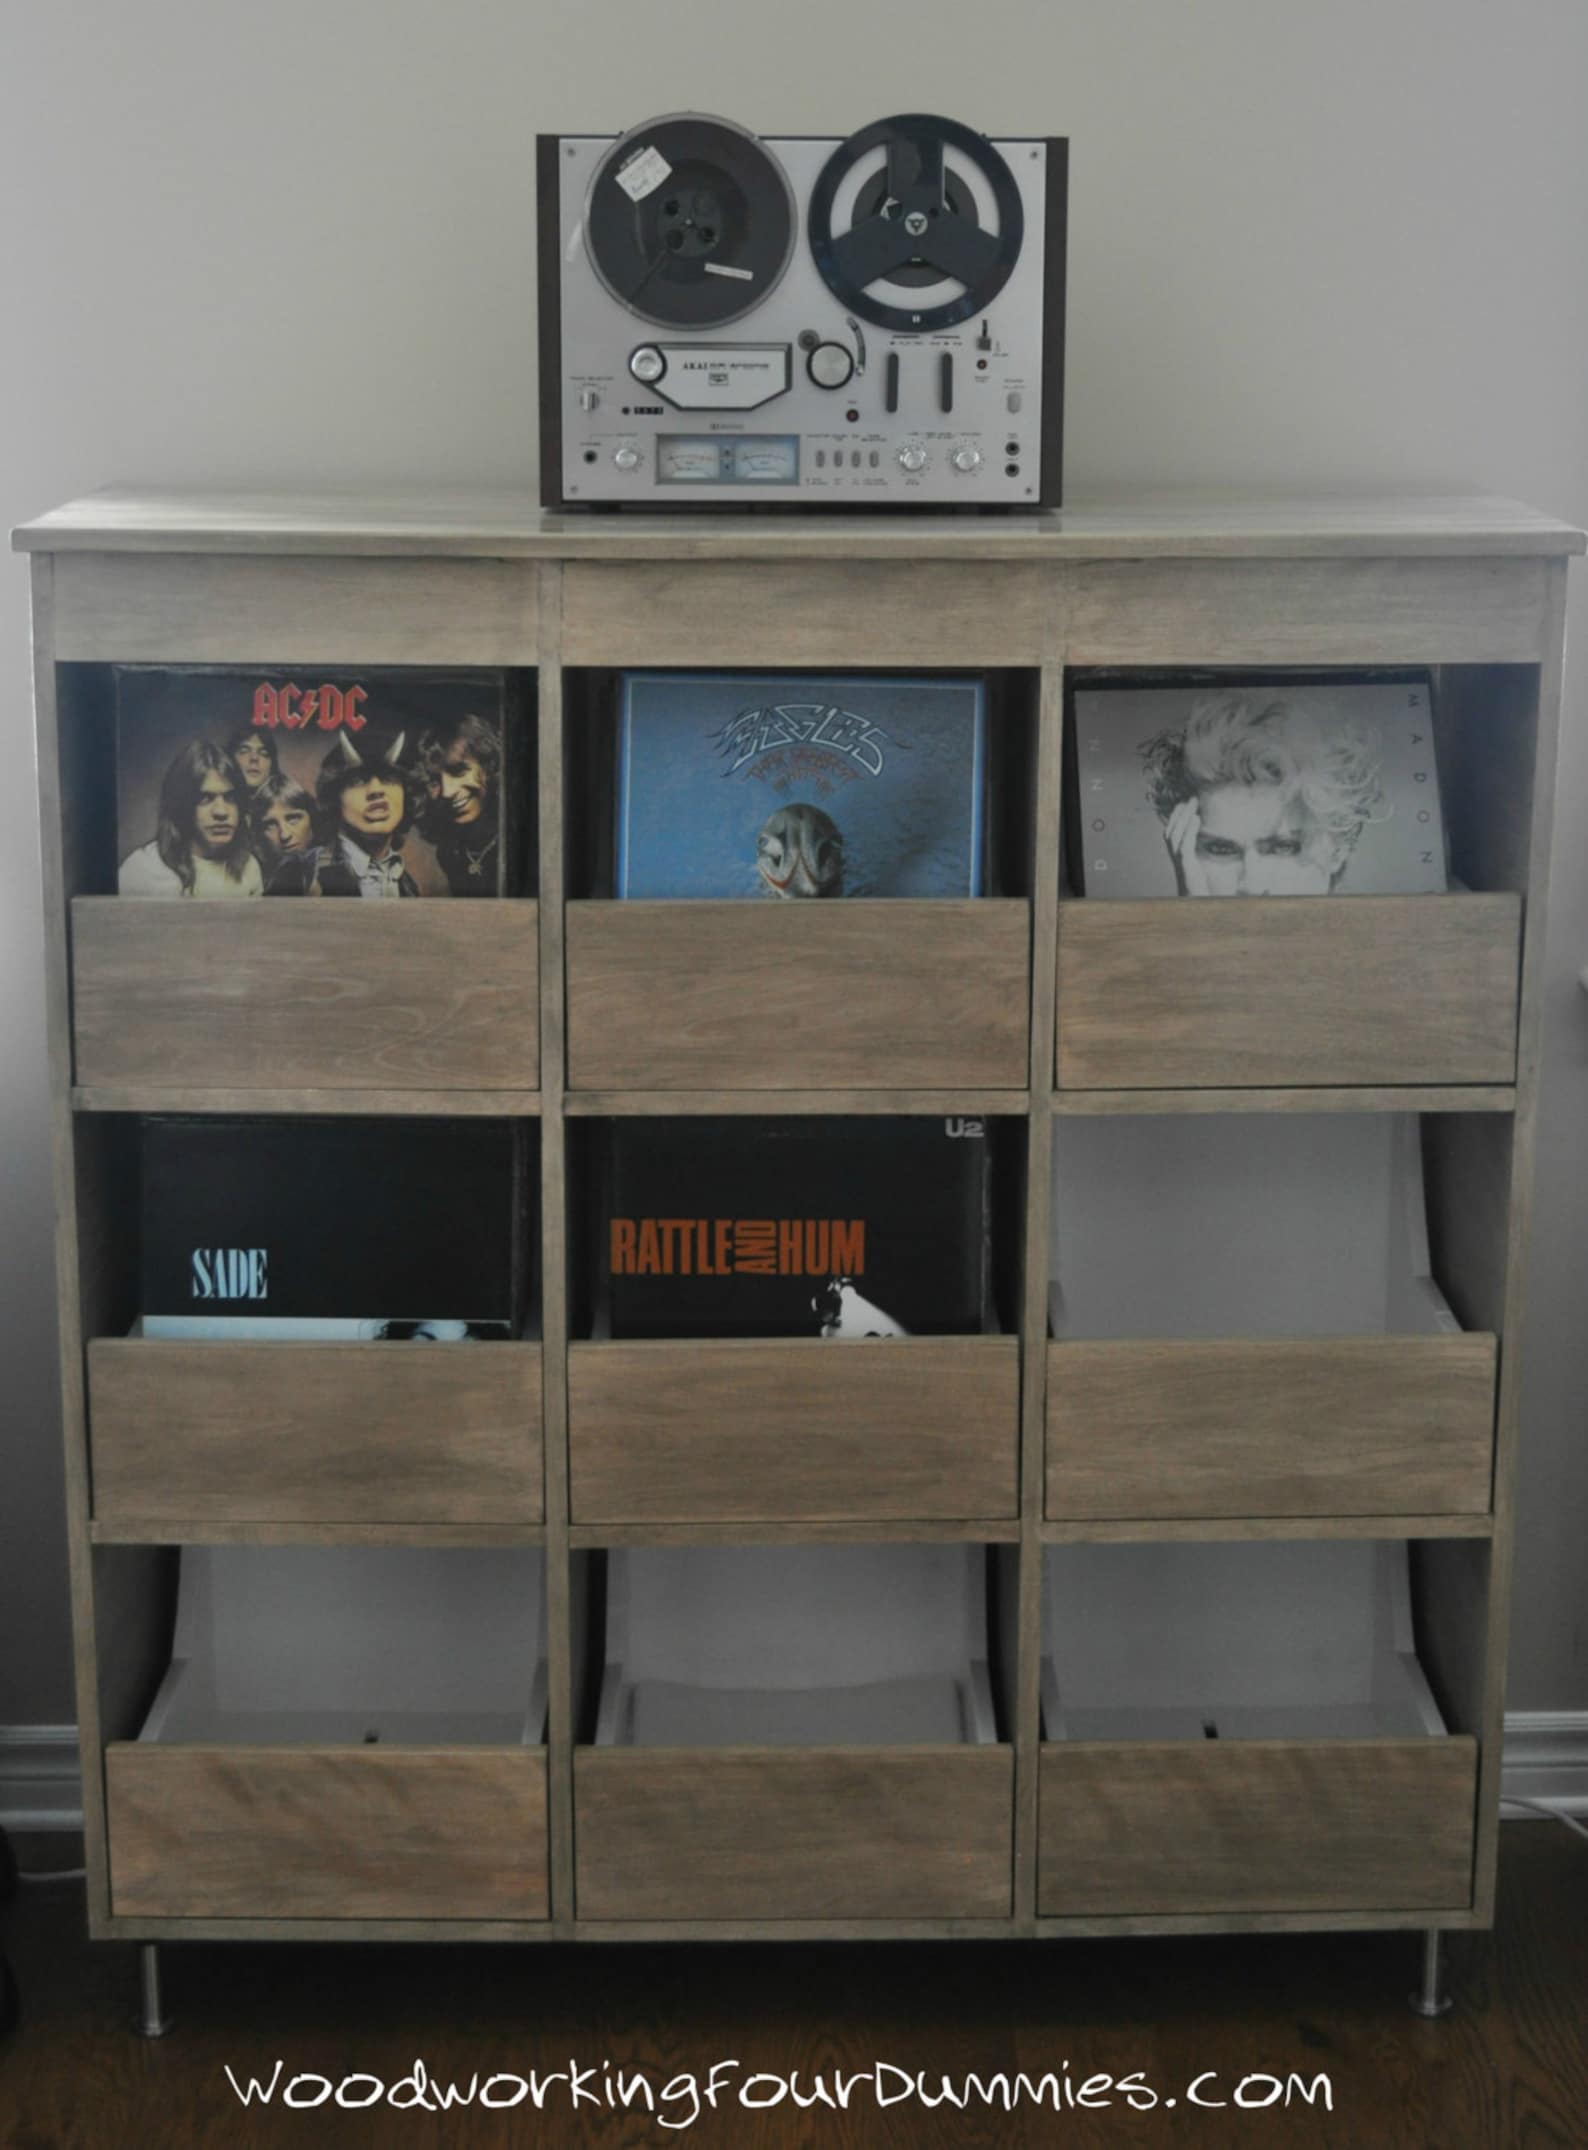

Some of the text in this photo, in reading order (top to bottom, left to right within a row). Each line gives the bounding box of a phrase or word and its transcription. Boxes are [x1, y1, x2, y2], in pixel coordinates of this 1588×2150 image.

[1407, 693, 1433, 866] MADON
[945, 1118, 984, 1138] U2
[192, 1248, 268, 1300] SADE
[610, 1219, 866, 1276] RATTLE AND HUM
